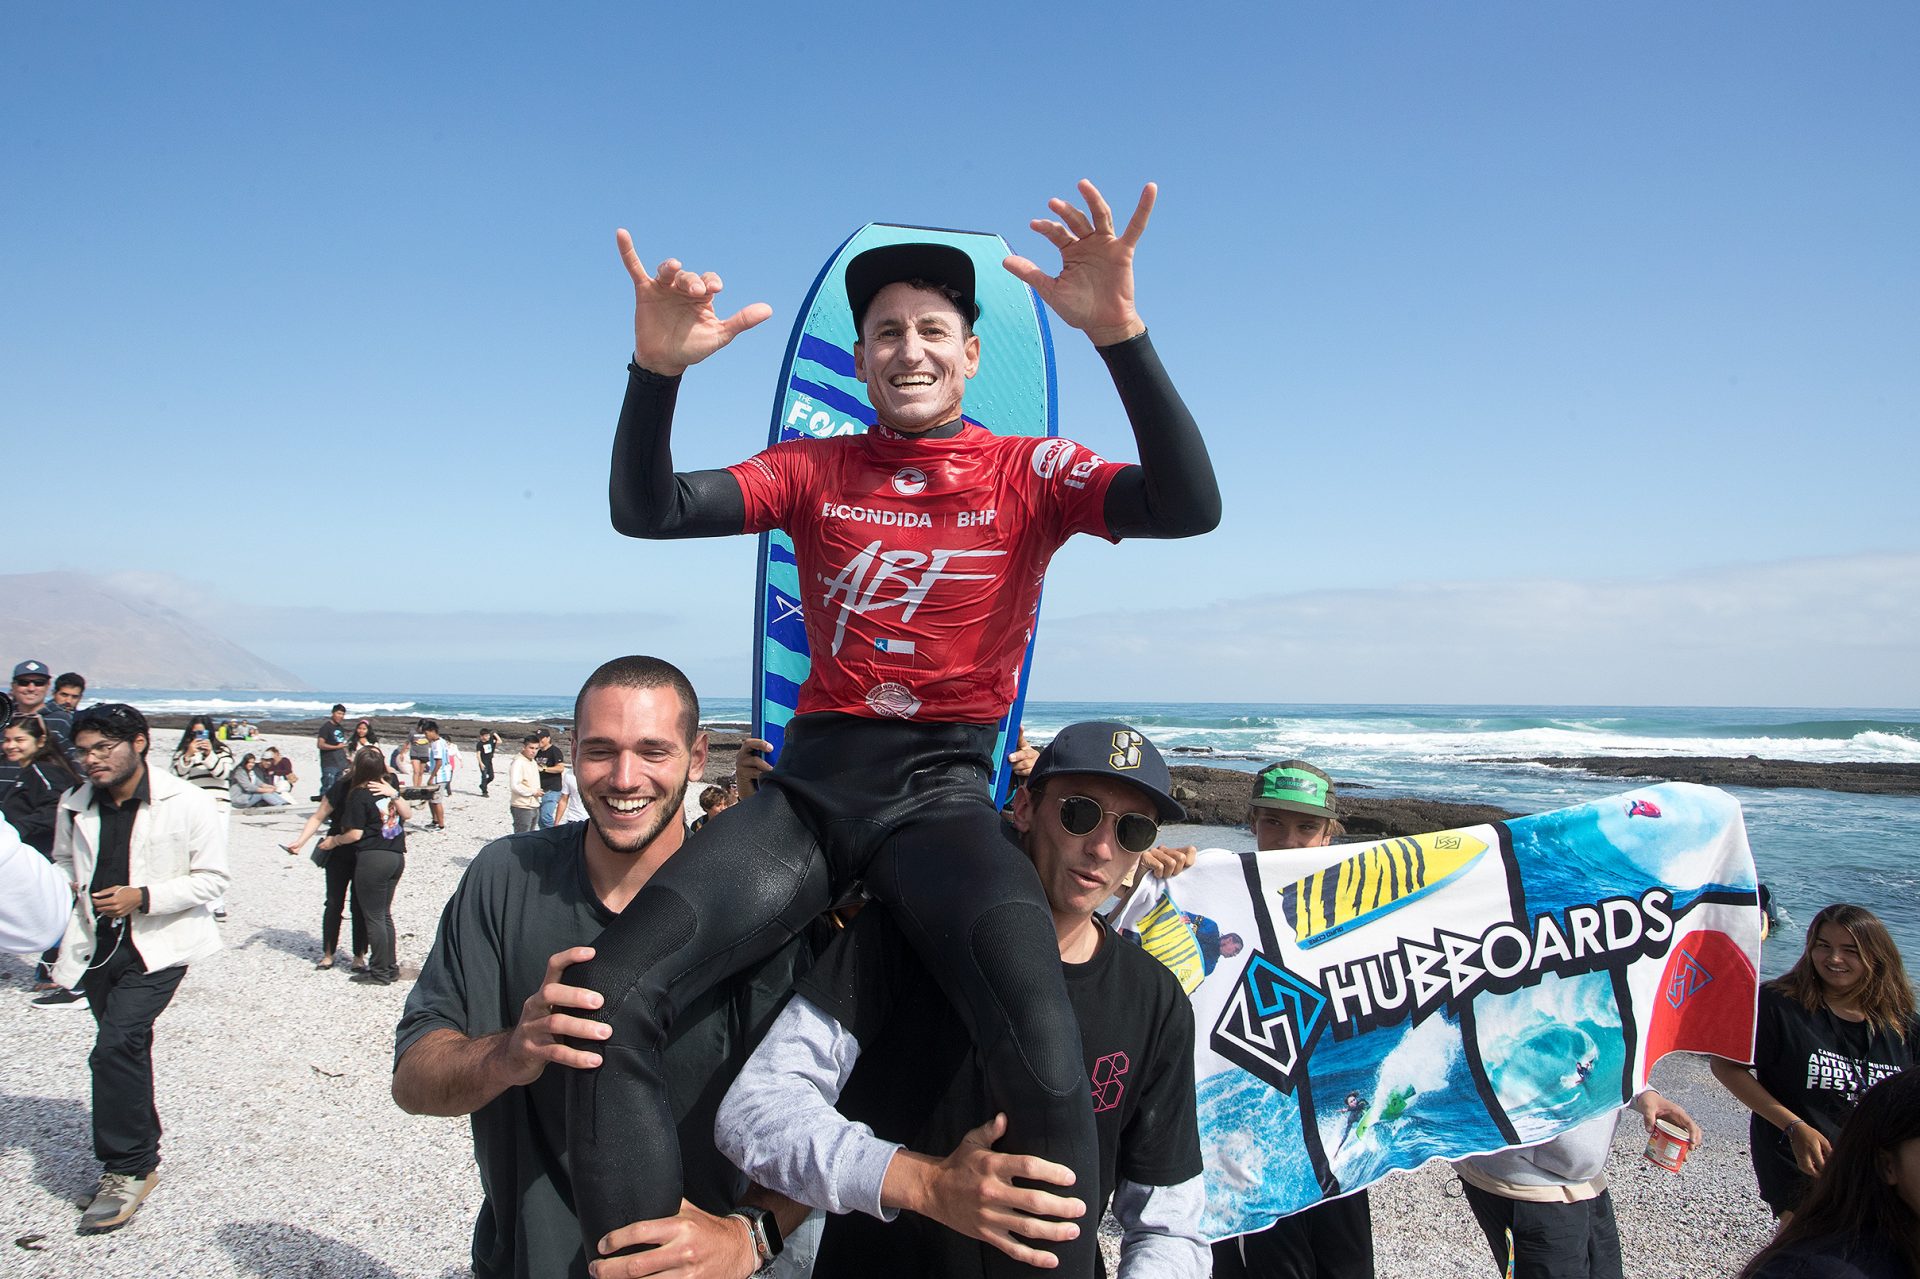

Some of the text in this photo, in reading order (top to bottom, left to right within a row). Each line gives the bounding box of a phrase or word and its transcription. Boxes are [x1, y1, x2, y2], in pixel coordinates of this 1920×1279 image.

[798, 393, 813, 404] THE
[787, 400, 869, 438] FOA
[957, 509, 998, 528] BHP
[818, 540, 1008, 657] ABF
[1325, 889, 1674, 1024] HUBBOARDS
[1868, 1061, 1902, 1073] MUNDIAL
